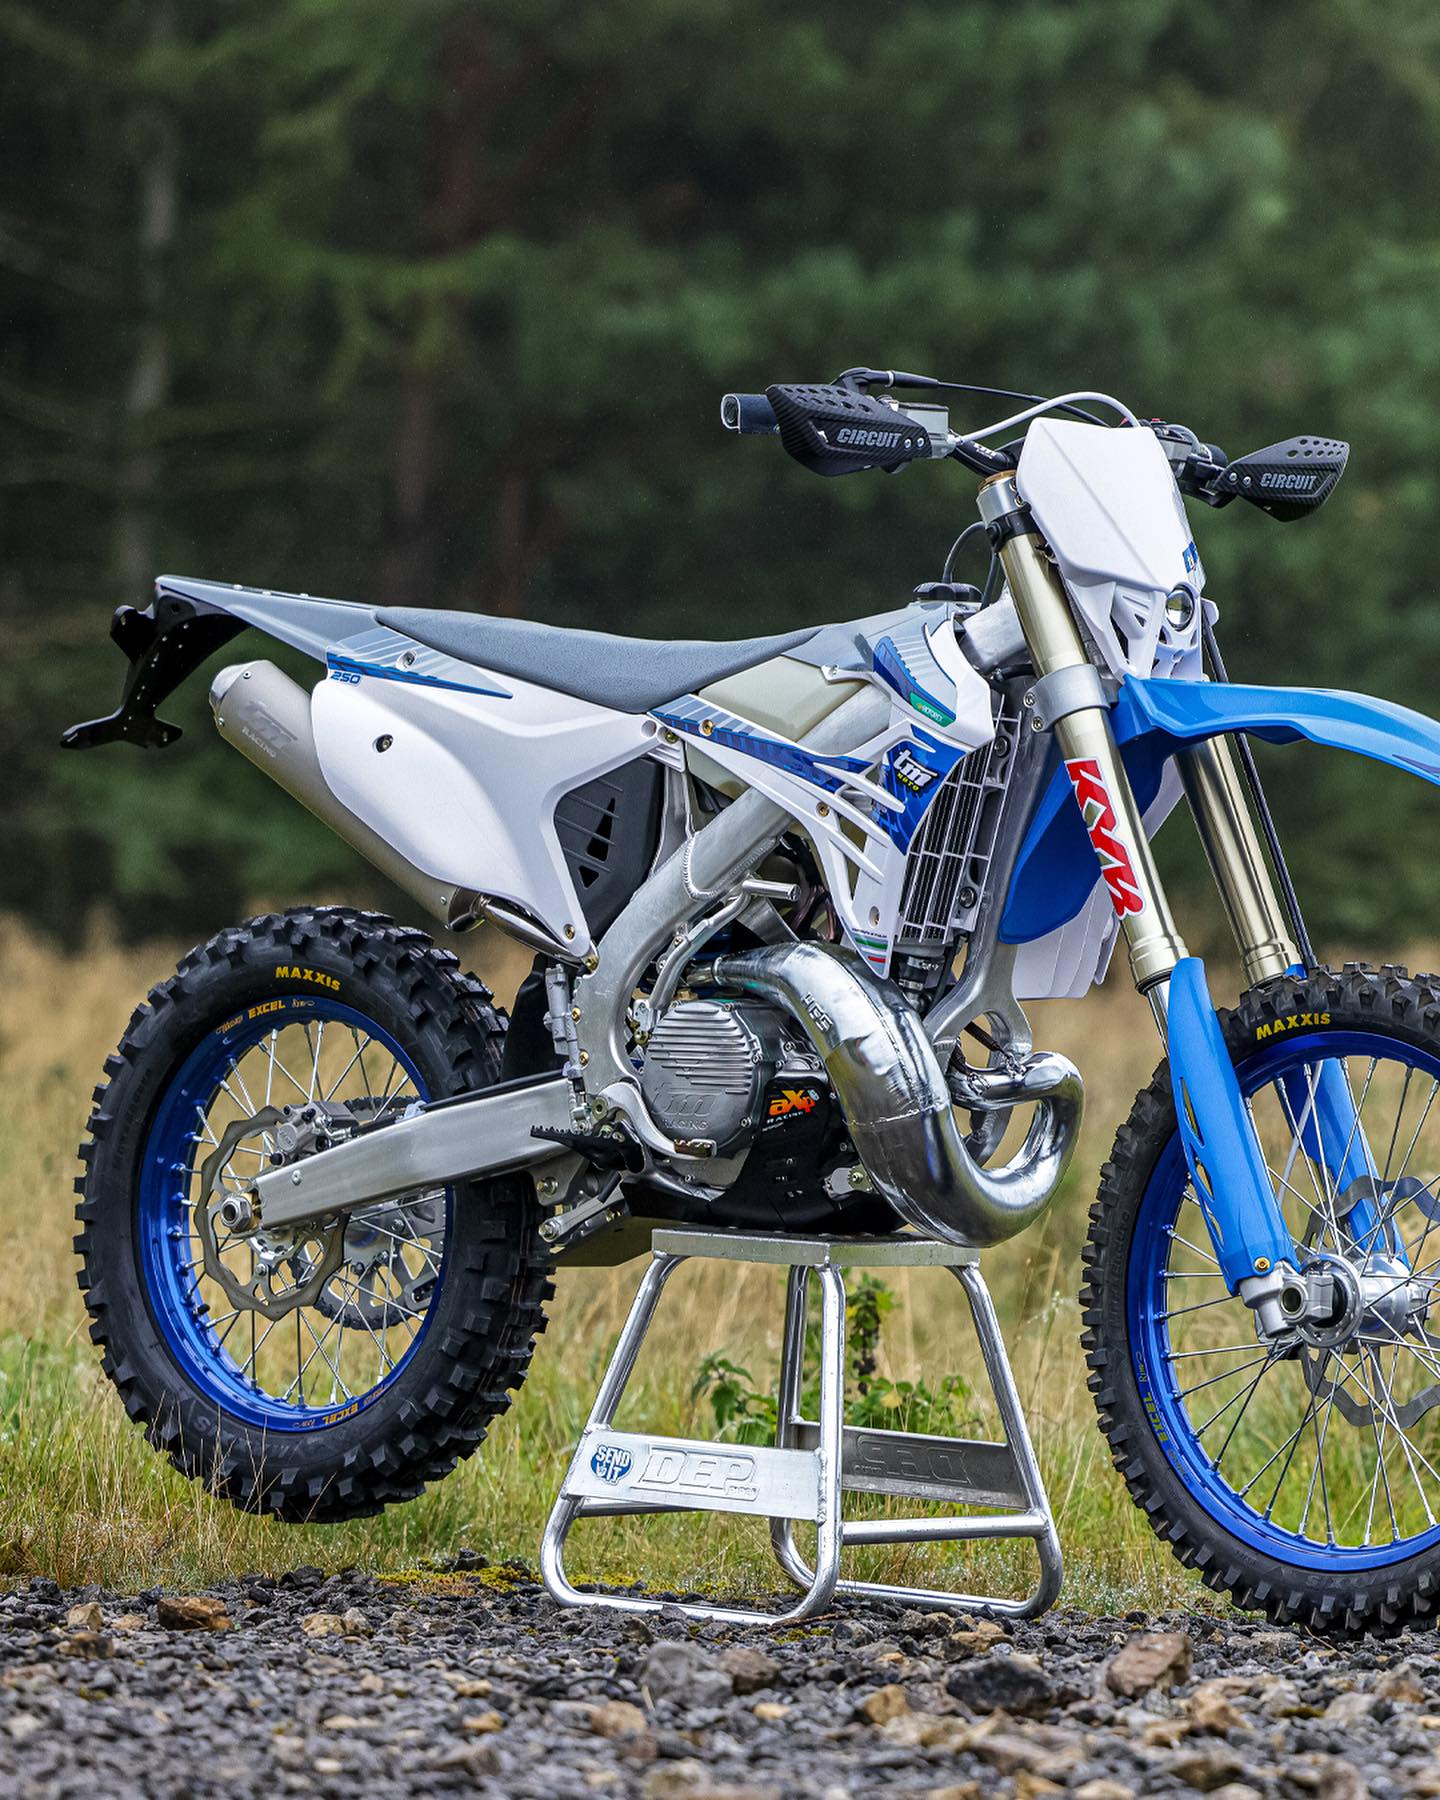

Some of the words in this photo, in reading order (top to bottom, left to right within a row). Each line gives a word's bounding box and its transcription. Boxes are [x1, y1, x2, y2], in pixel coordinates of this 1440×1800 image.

[837, 428, 902, 448] CIRCUIT
[1260, 472, 1317, 490] CIRCUIT
[330, 671, 361, 684] 250
[275, 966, 341, 991] MAXXIS
[248, 1000, 286, 1019] EXCEL
[1256, 1012, 1331, 1041] MAXXIS
[322, 1403, 359, 1425] EXCEL
[1143, 1392, 1169, 1442] EXCEL
[595, 1446, 631, 1468] SEND
[638, 1447, 756, 1490] DEP
